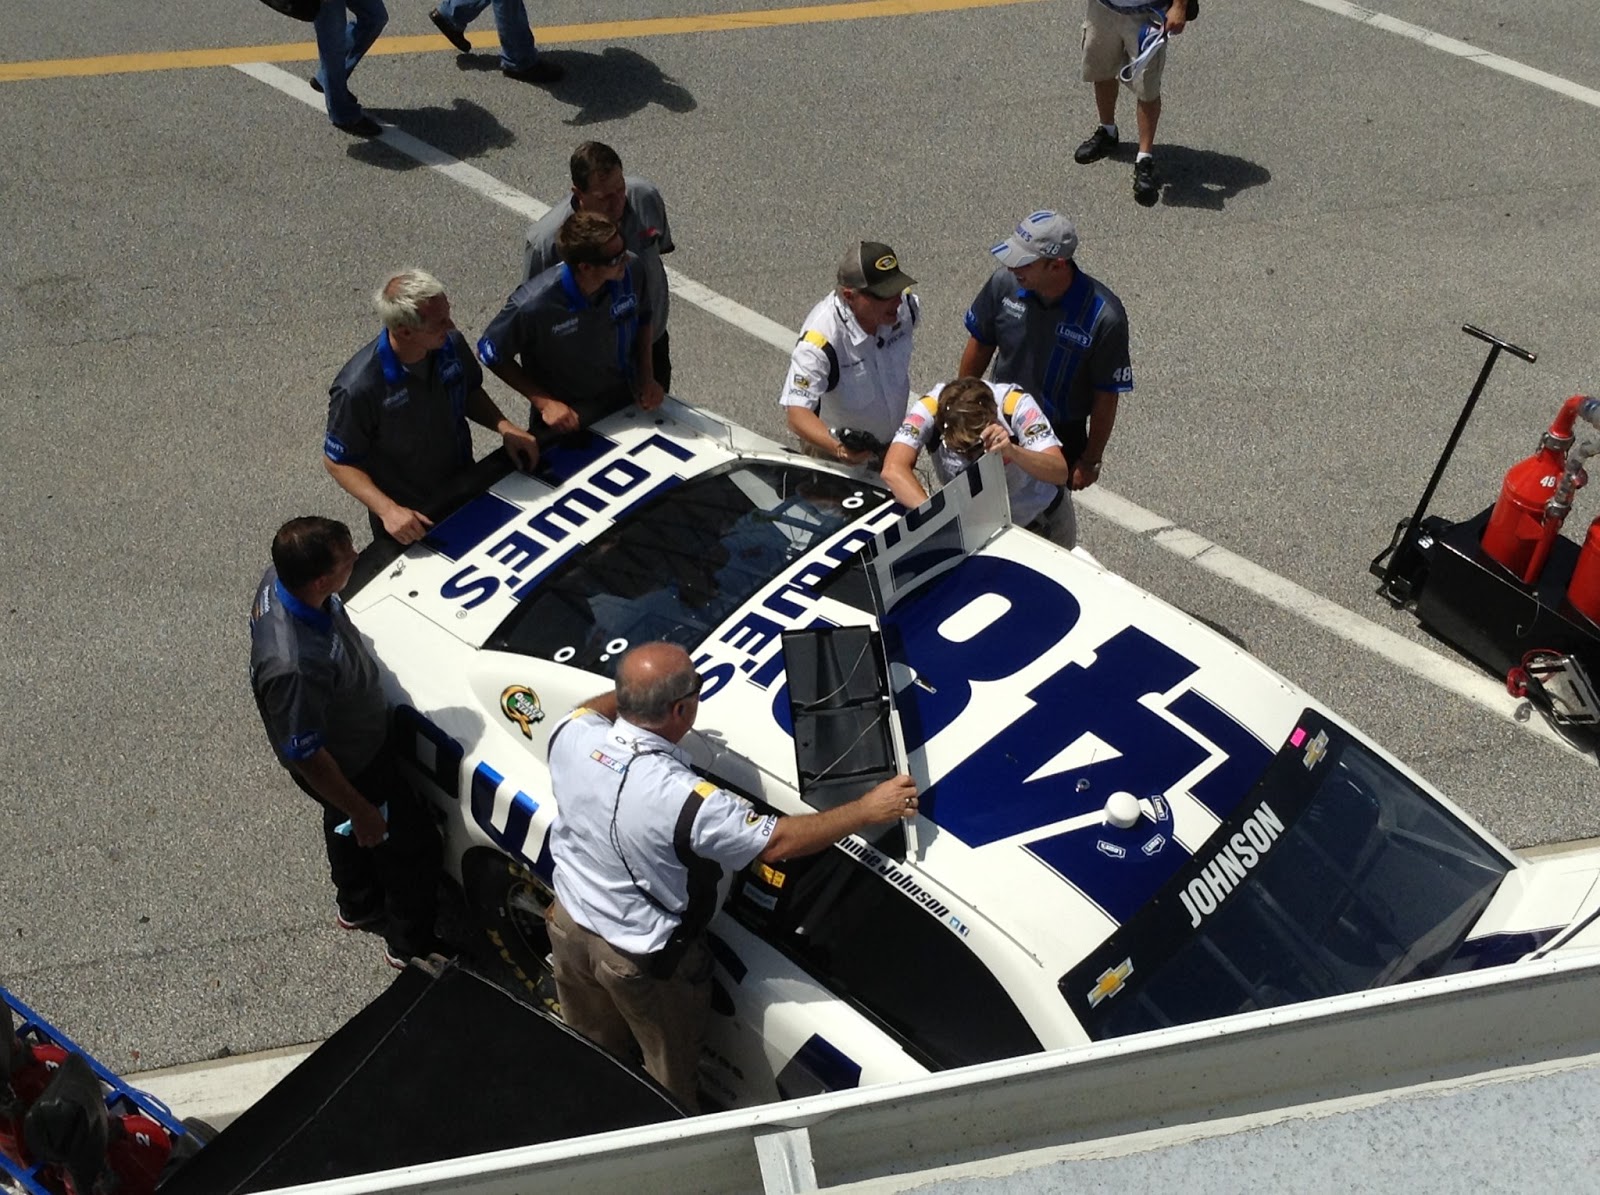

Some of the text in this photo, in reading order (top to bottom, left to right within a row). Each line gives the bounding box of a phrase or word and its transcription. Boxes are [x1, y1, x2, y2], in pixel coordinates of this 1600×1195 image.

[1045, 243, 1061, 255] 48
[1059, 325, 1089, 345] LOWE'S
[1112, 366, 1132, 382] 48
[1539, 475, 1556, 487] 48
[440, 433, 696, 611] LOWE'S
[514, 691, 545, 719] QUAKER
[514, 701, 538, 721] STATE
[772, 554, 1214, 849] 48
[1178, 801, 1285, 929] JOHNSON
[840, 836, 950, 918] mmie Johnson
[135, 1131, 150, 1147] 2
